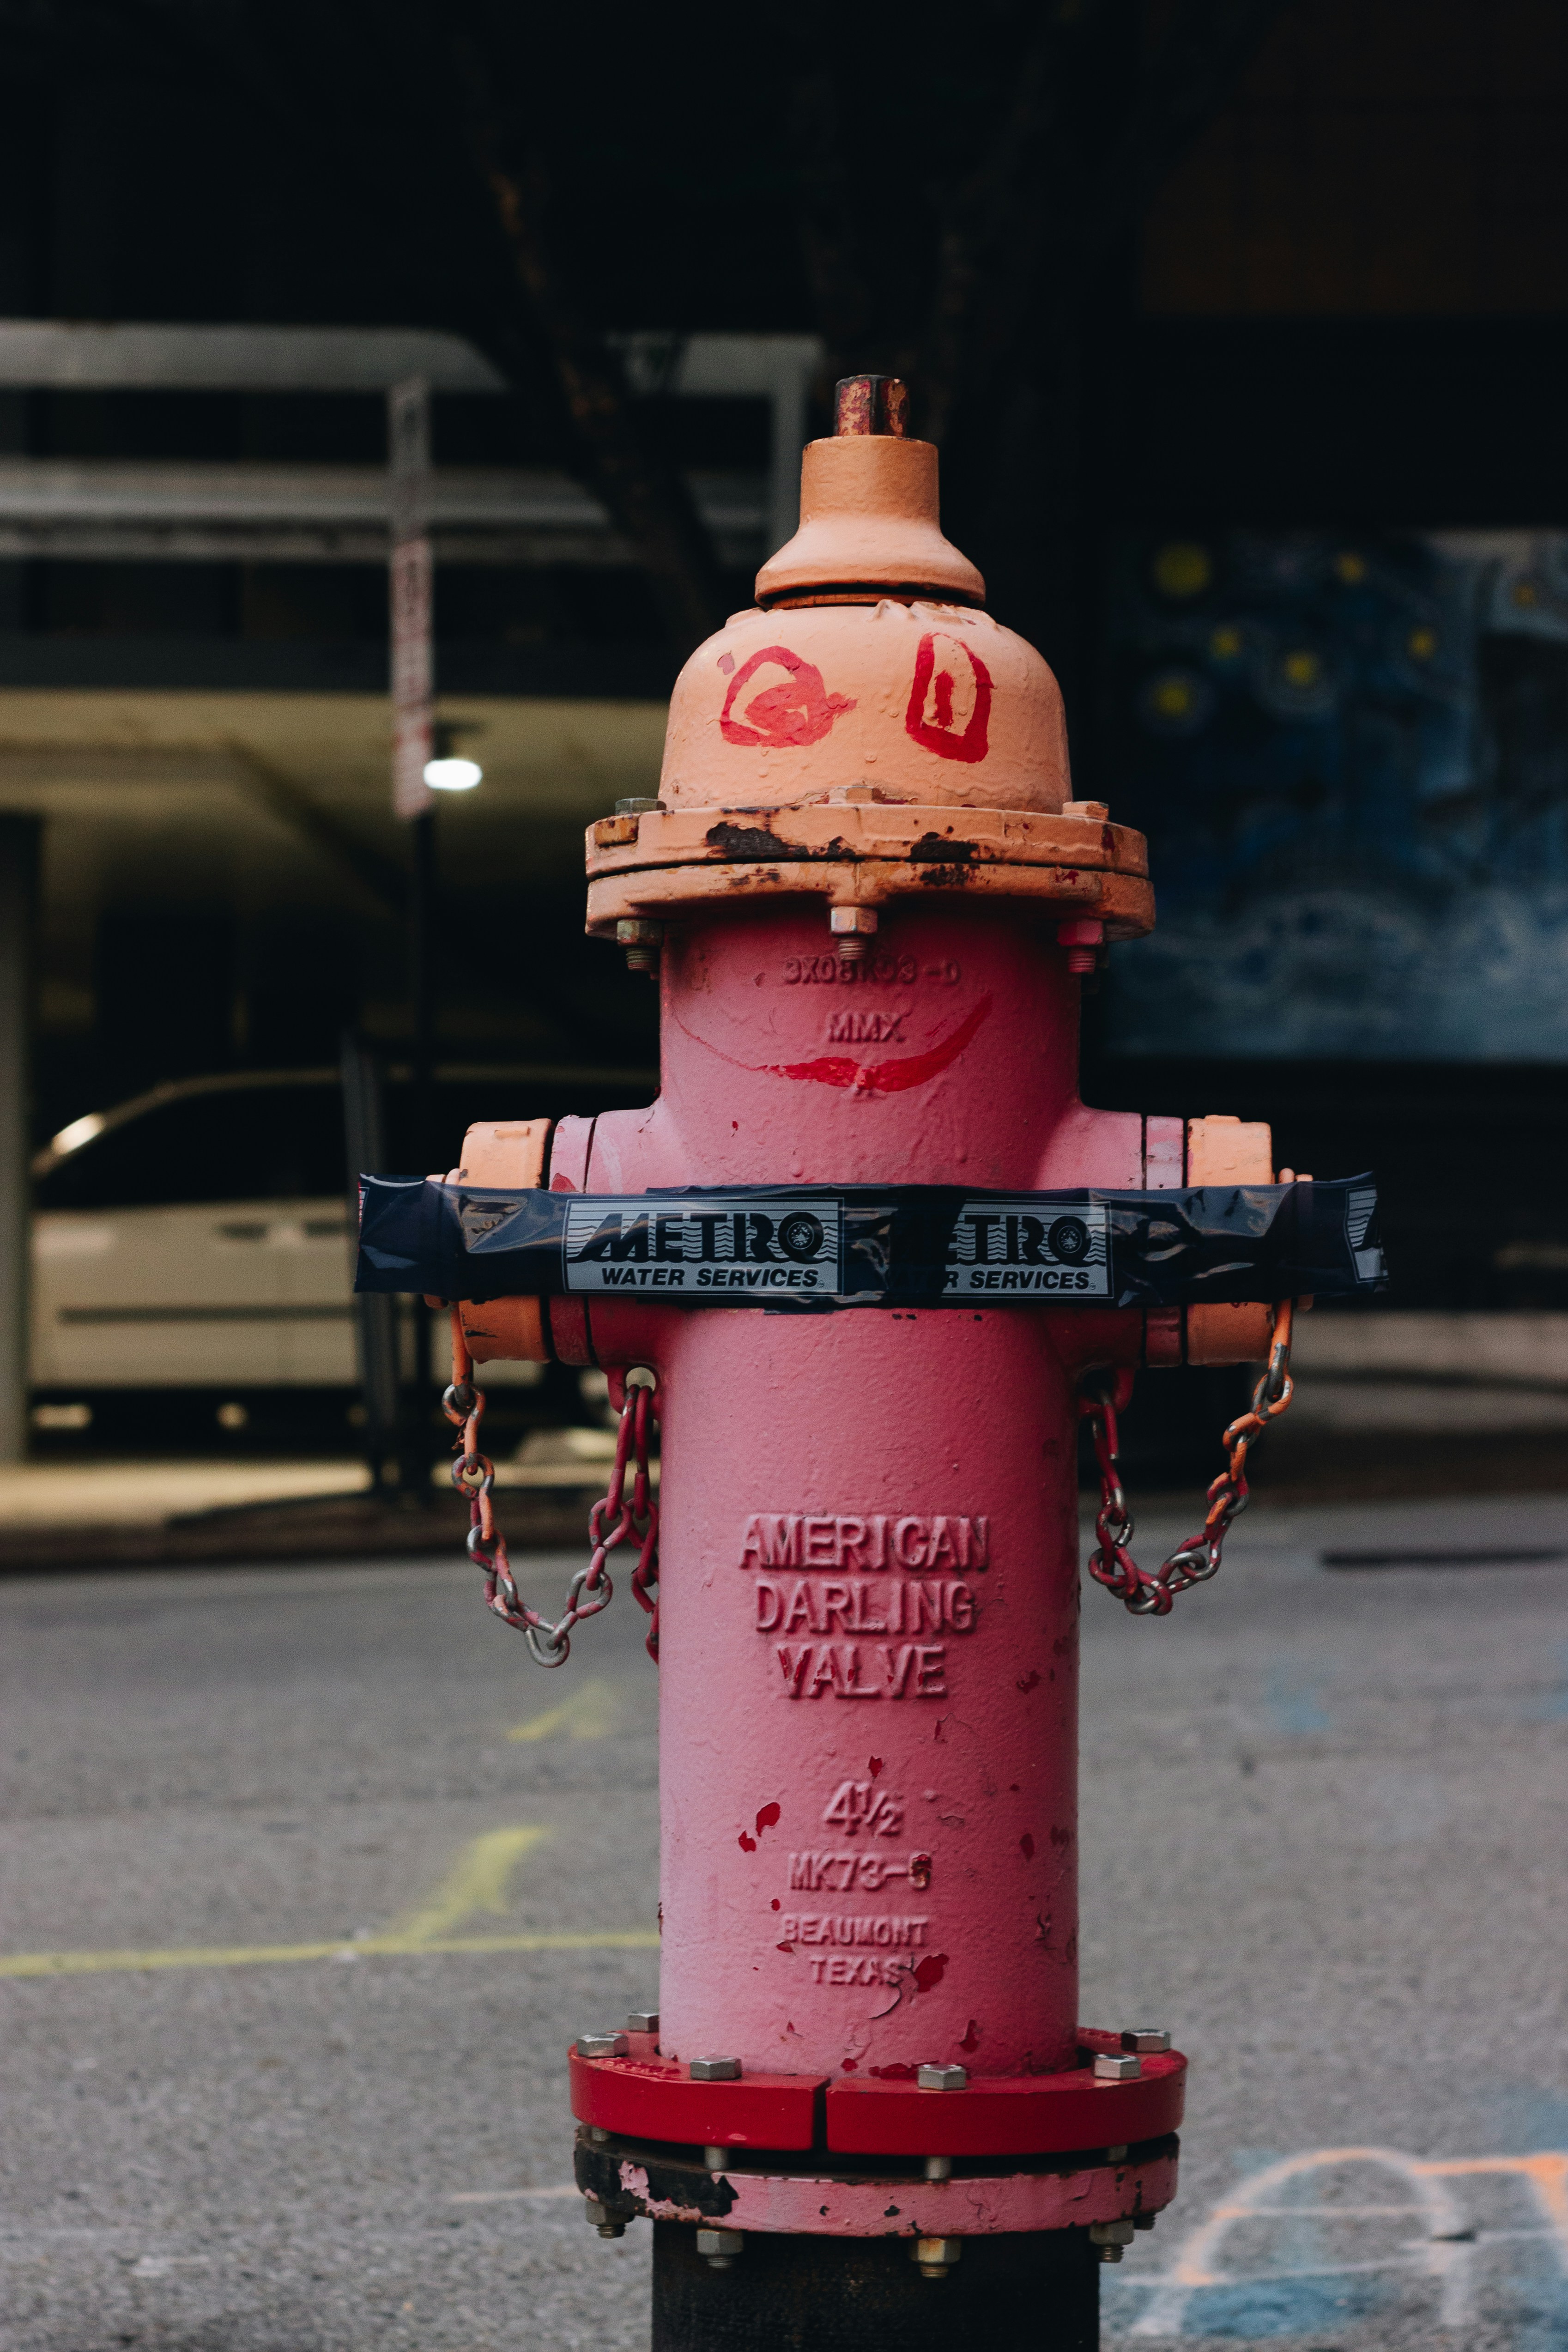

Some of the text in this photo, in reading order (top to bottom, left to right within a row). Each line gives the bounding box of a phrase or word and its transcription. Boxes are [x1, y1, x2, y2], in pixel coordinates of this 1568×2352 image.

[826, 1010, 908, 1043] MMX
[578, 1212, 824, 1262] METRO
[948, 1215, 1092, 1266] TRO
[602, 1267, 819, 1287] WATER SERVICES
[969, 1270, 1090, 1290] SERVICES
[739, 1513, 989, 1571] AMERICAN
[755, 1579, 976, 1634] DARLING
[777, 1643, 948, 1699] VALVE
[784, 1915, 928, 1947] BEAUMONT
[810, 1955, 904, 1986] TEXAS
